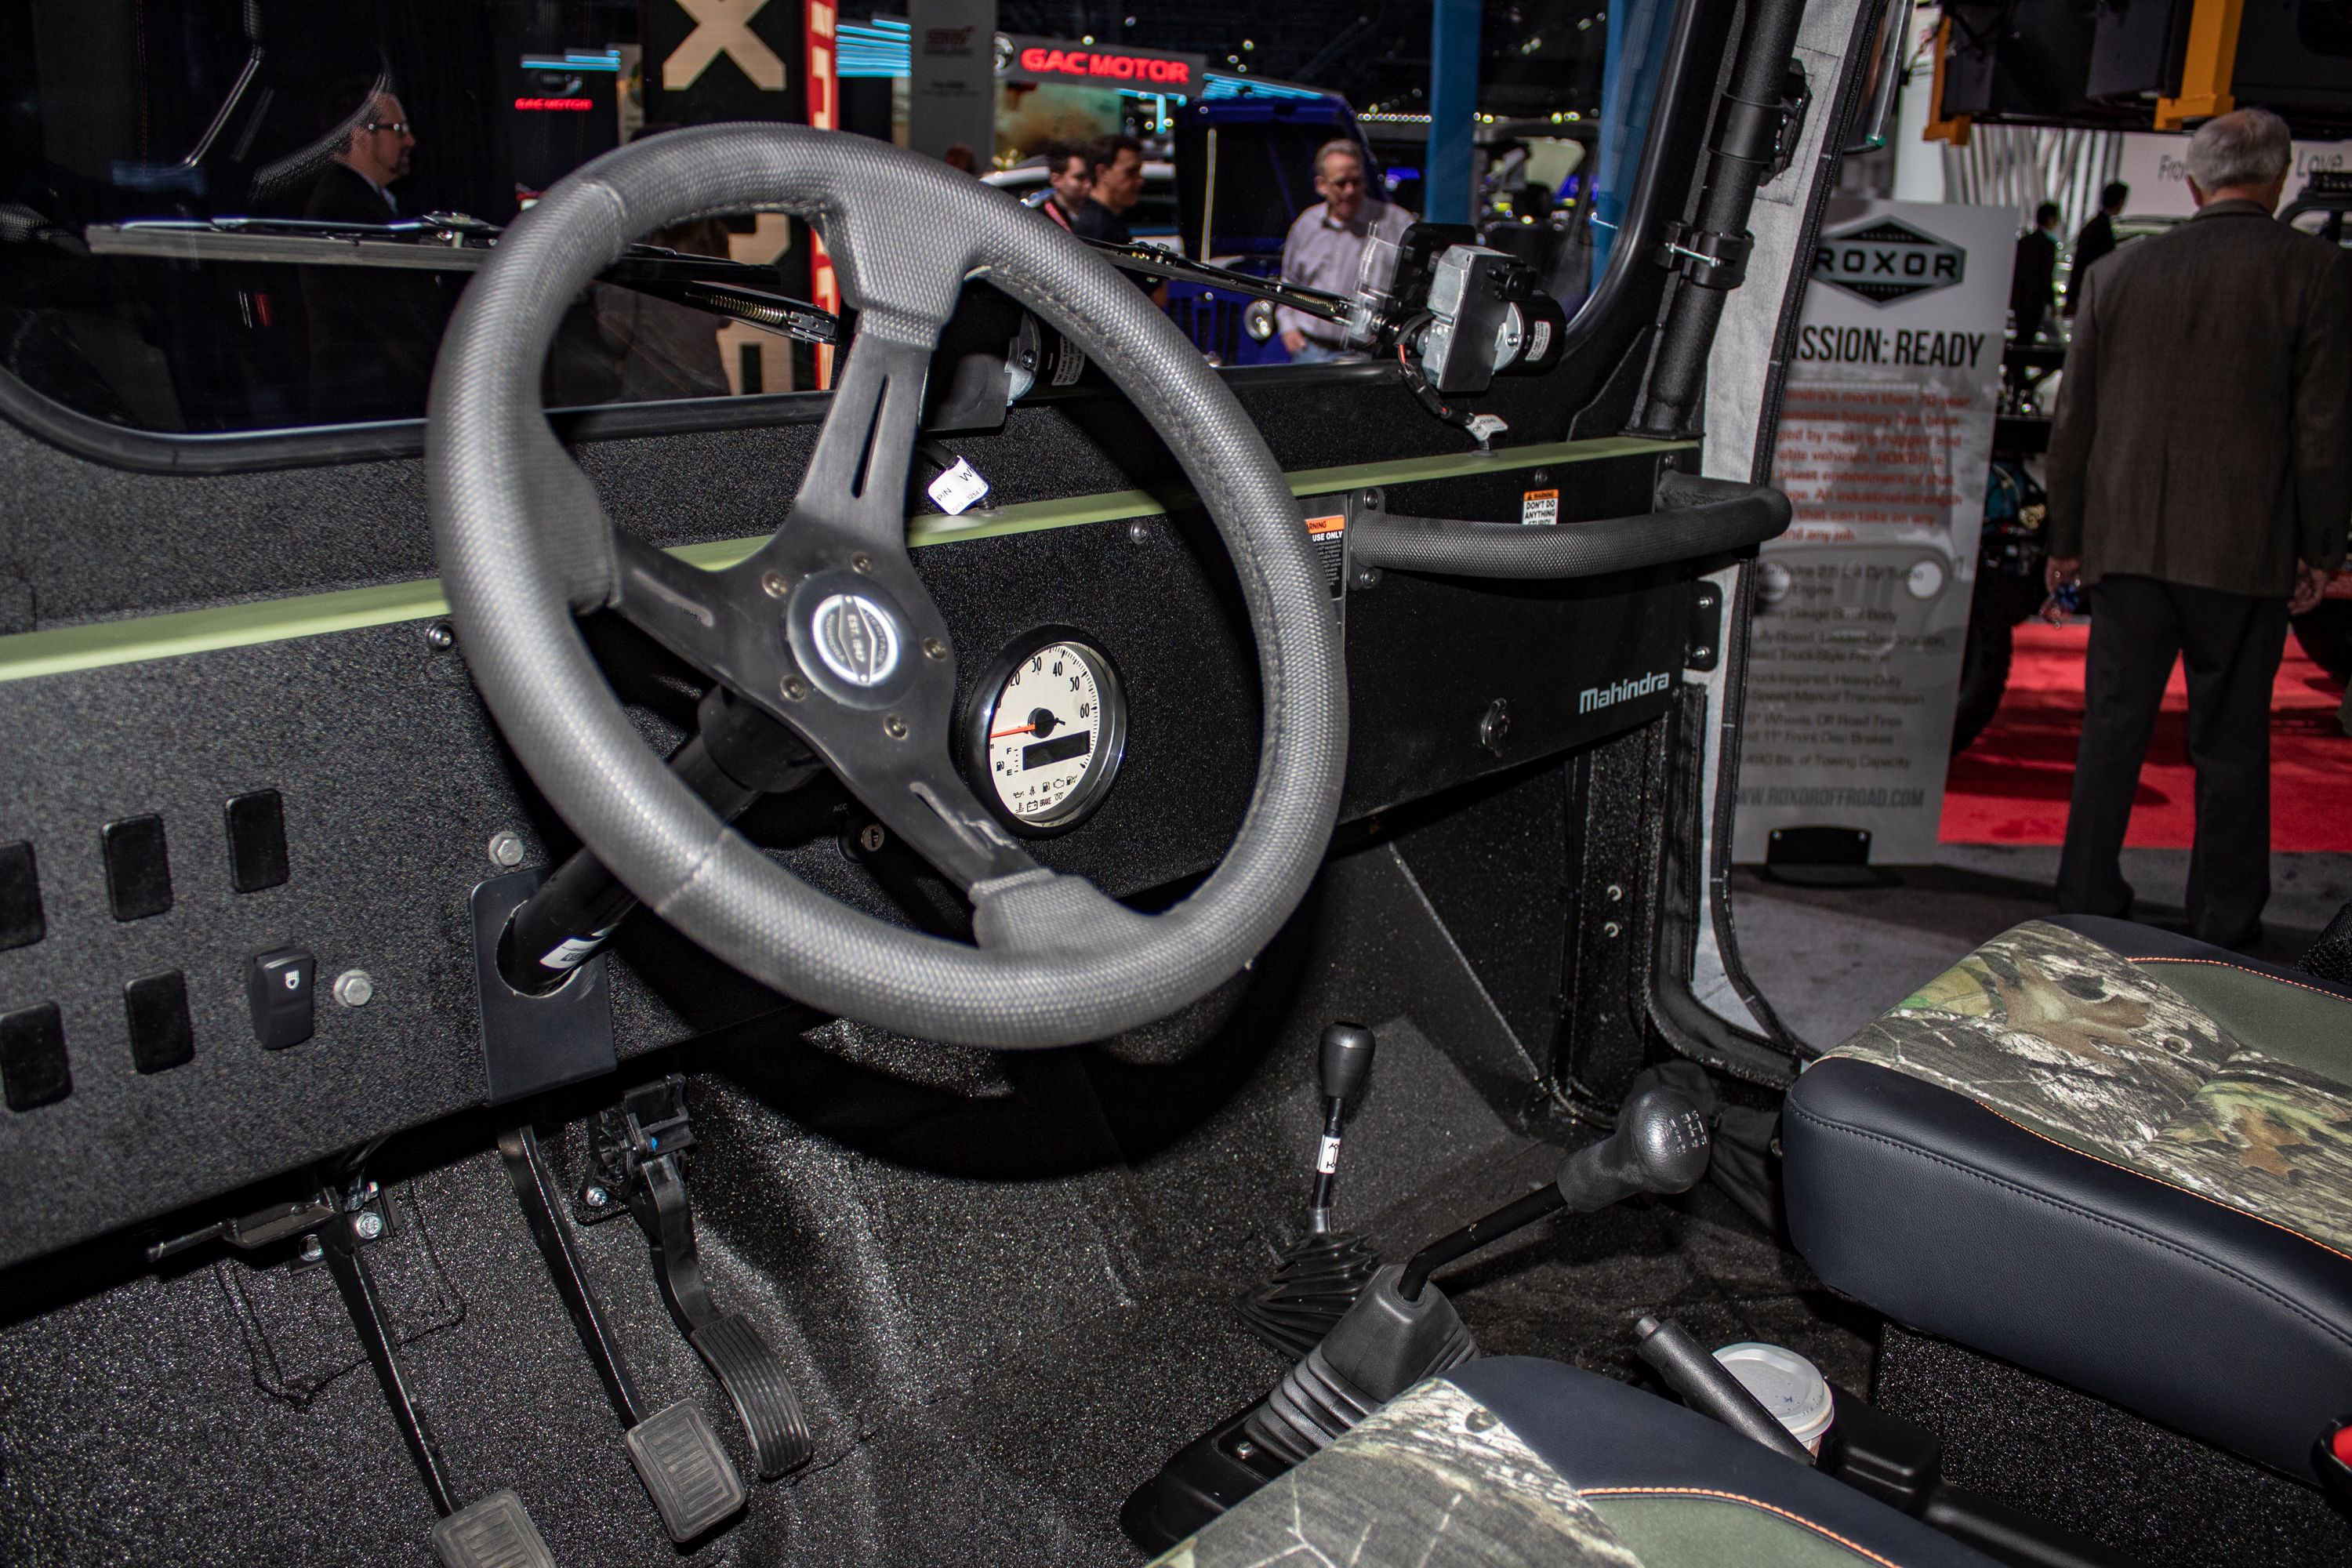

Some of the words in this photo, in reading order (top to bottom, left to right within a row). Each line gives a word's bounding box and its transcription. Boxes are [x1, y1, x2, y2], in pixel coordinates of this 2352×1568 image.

[1021, 48, 1088, 75] GAC
[1089, 54, 1189, 84] MOTOR
[1813, 248, 1958, 278] ROXOR
[1791, 325, 1889, 365] ISSION:
[1894, 328, 1986, 368] READY
[1526, 500, 1544, 510] DON'T
[1546, 499, 1555, 508] DO
[1525, 509, 1555, 519] ANYTHING
[1307, 521, 1327, 531] RNING
[1312, 533, 1325, 542] USE
[1326, 530, 1343, 540] ONLY
[848, 614, 861, 637] EST.
[852, 638, 866, 662] 1947
[1032, 656, 1042, 673] 30
[1053, 661, 1063, 677] 40
[1069, 676, 1080, 692] 50
[1580, 672, 1670, 714] Mahindra
[1080, 702, 1090, 718] 60
[833, 803, 848, 813] ACC
[1040, 797, 1052, 807] BRAKE
